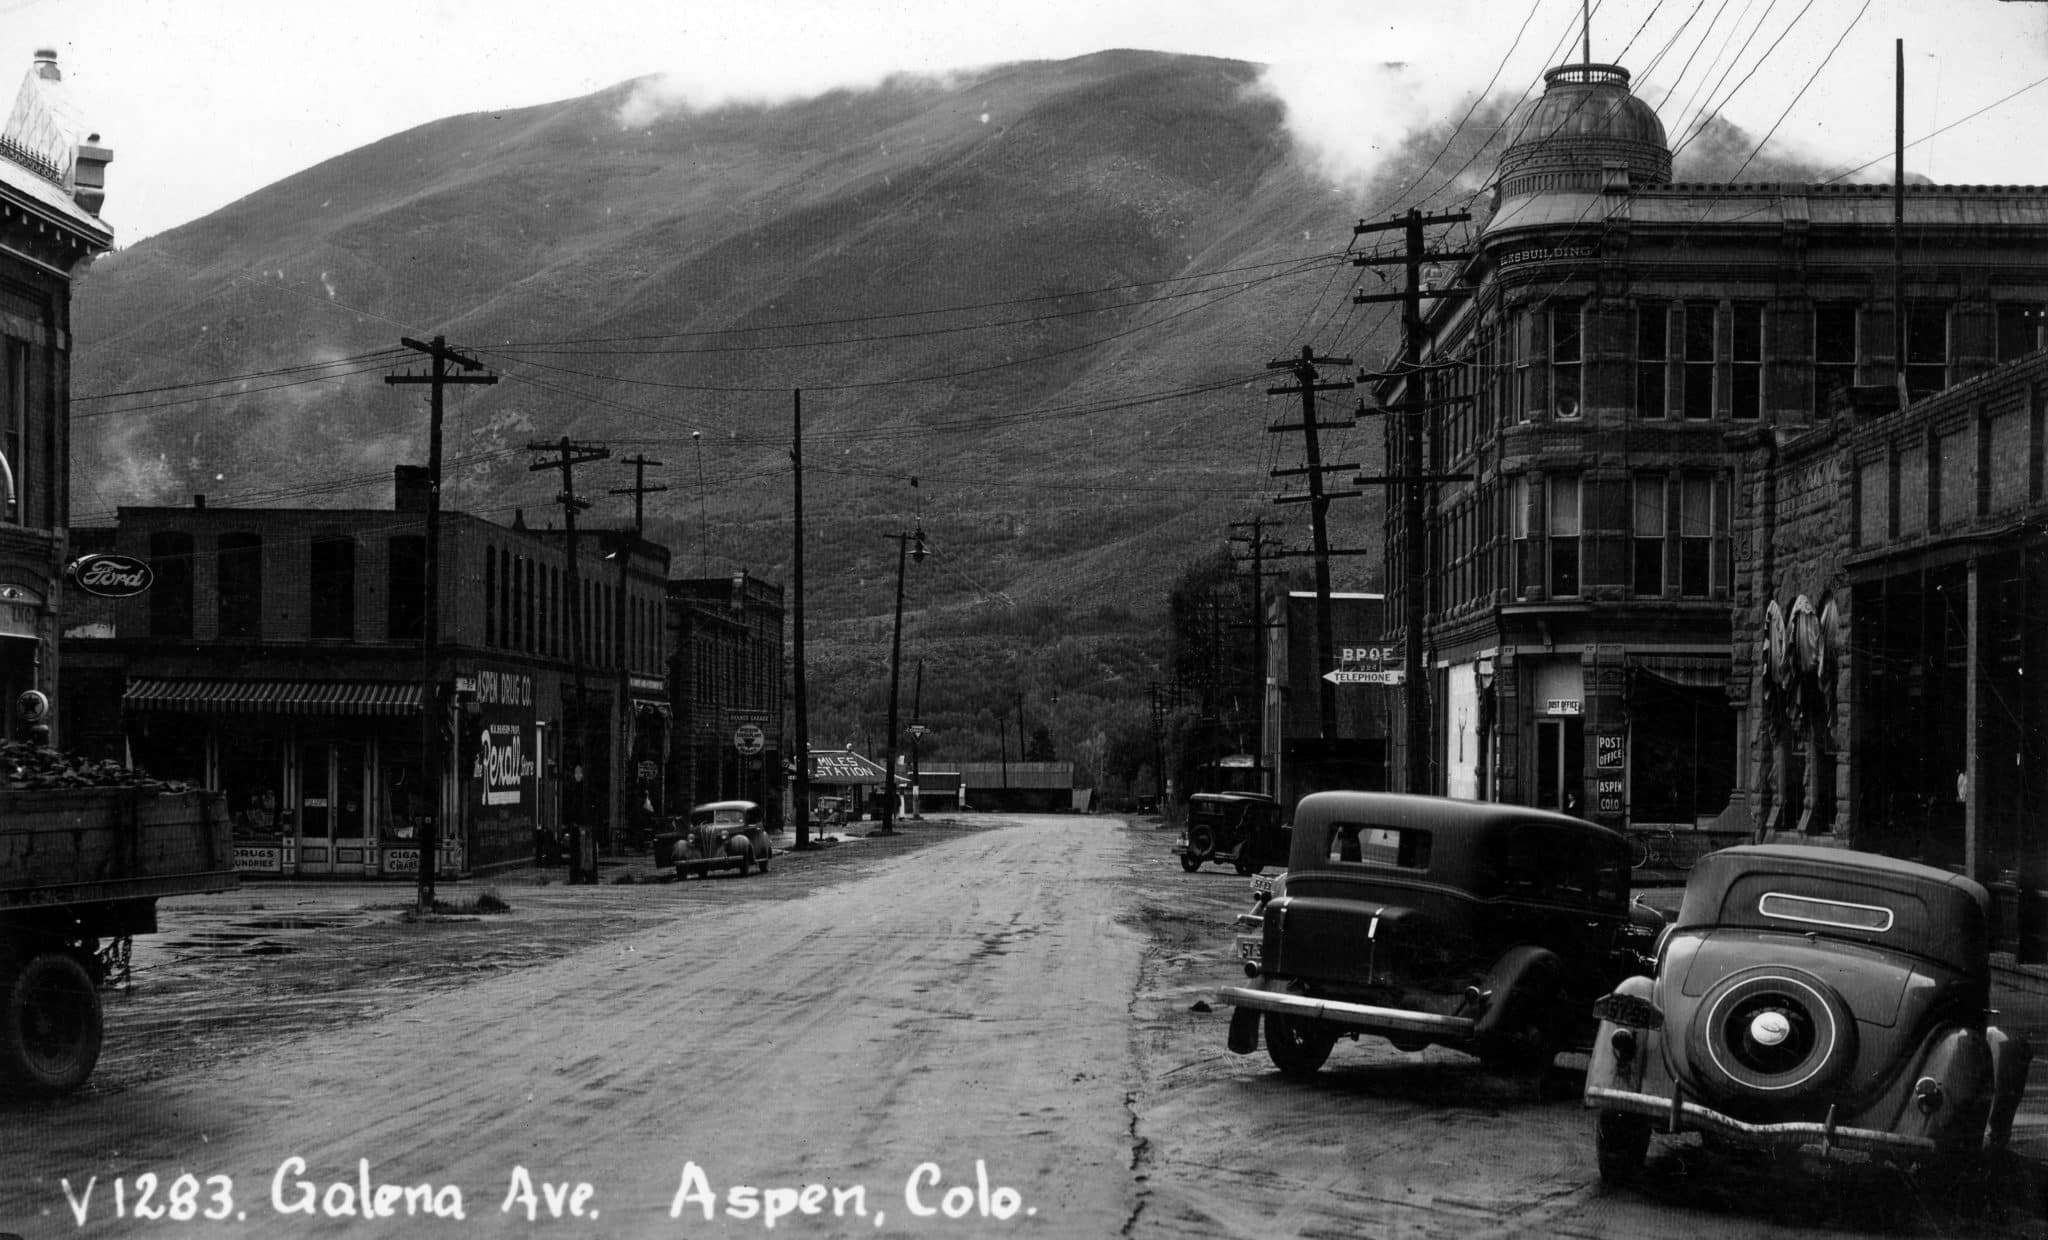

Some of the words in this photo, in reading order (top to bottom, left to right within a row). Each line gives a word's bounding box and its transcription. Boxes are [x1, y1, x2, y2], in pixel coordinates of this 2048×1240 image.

[1521, 246, 1592, 261] BUILDING
[83, 560, 144, 587] Ford
[1335, 674, 1390, 682] TELEPHONE
[477, 670, 499, 704] ASPEN
[501, 672, 520, 705] DRUG
[521, 675, 533, 708] CO.
[1548, 701, 1560, 709] POST
[1561, 701, 1579, 711] OFFICE
[1599, 736, 1622, 749] POST
[817, 756, 858, 768] MILES
[1599, 750, 1622, 765] OFFICE
[481, 729, 520, 806] Rexall
[815, 766, 875, 777] STATION
[1599, 780, 1622, 793] ASPEN
